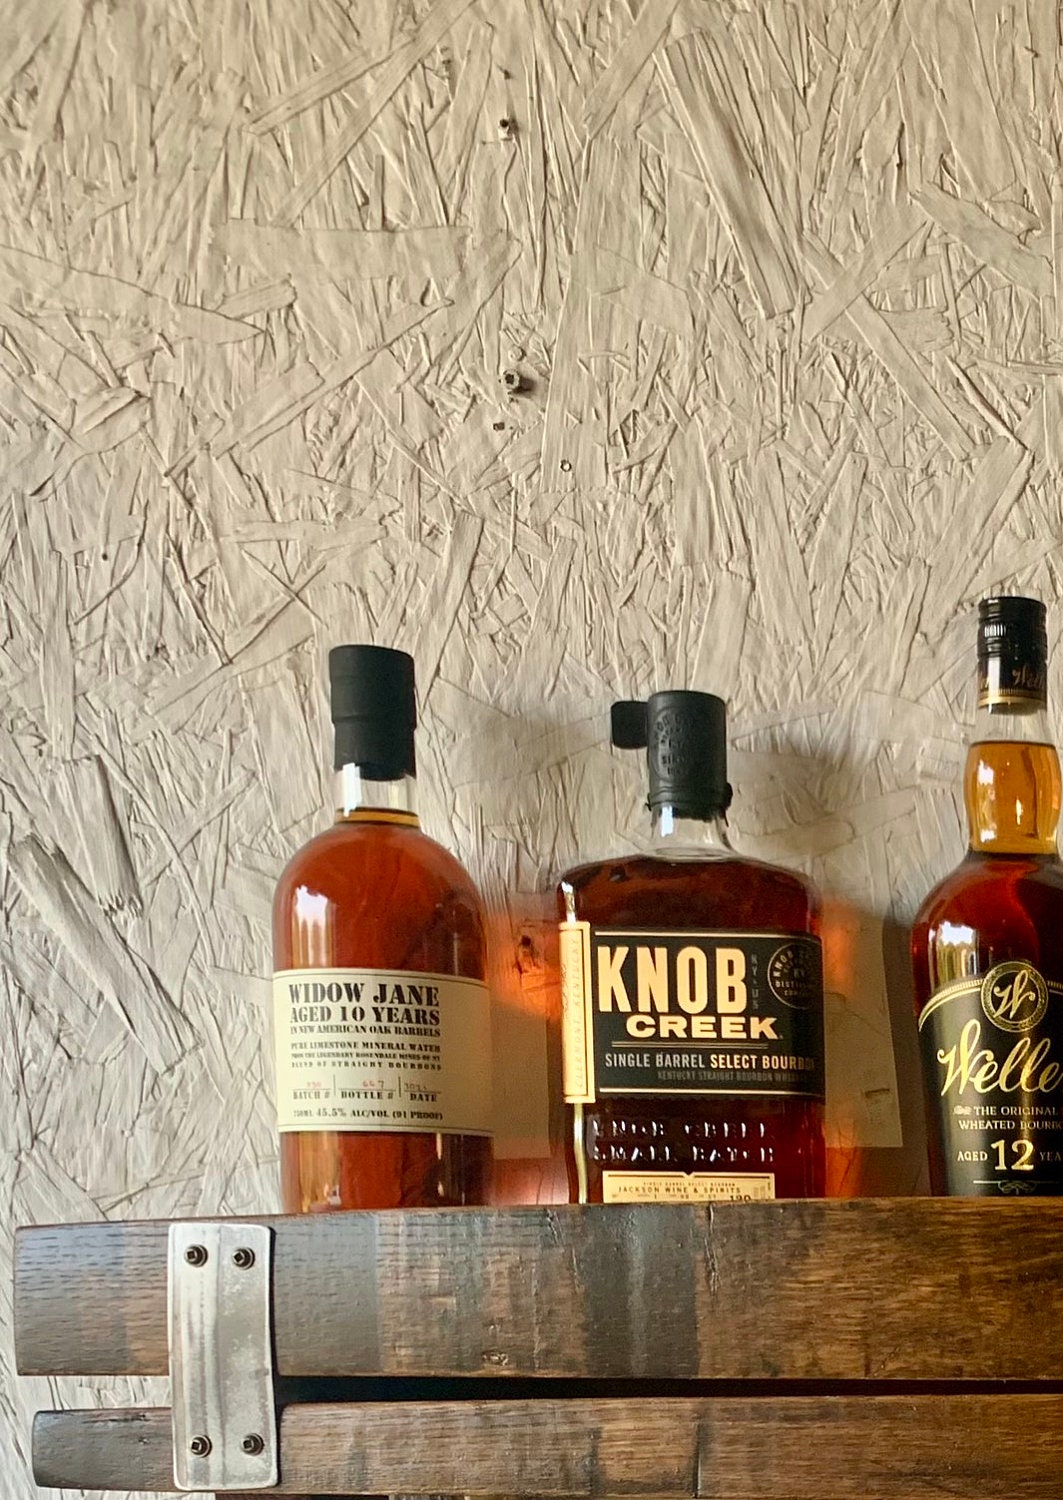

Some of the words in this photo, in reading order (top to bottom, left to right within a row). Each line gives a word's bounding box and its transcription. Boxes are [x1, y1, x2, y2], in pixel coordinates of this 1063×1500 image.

[597, 945, 747, 1015] KNOB
[289, 983, 365, 1005] WIDOW
[373, 983, 439, 1007] JANE
[290, 1006, 332, 1023] AGED
[340, 1006, 365, 1022] 10
[371, 1007, 440, 1026] YEARS
[317, 1025, 367, 1034] AMERICAN
[370, 1025, 392, 1035] OAK
[394, 1026, 441, 1037] BARRELS
[626, 1014, 781, 1040] CREEK
[362, 1042, 405, 1051] MINERAL
[409, 1044, 441, 1053] WATER
[331, 1061, 383, 1069] STRAIGHT
[605, 1053, 650, 1067] SINGLE
[656, 1053, 706, 1068] BARREL
[710, 1054, 757, 1069] SELECT
[292, 1090, 321, 1100] BATCH
[341, 1090, 383, 1100] BOTTLE
[410, 1093, 438, 1102] DATE
[350, 1110, 390, 1118] ALC/VOL
[973, 1106, 997, 1115] THE
[1000, 1106, 1059, 1116] ORIGINAL
[958, 1119, 1015, 1130] WHEATED
[957, 1151, 988, 1162] AGED
[990, 1139, 1035, 1171] 12
[618, 1186, 660, 1194] JACKSON
[665, 1186, 688, 1194] WINE
